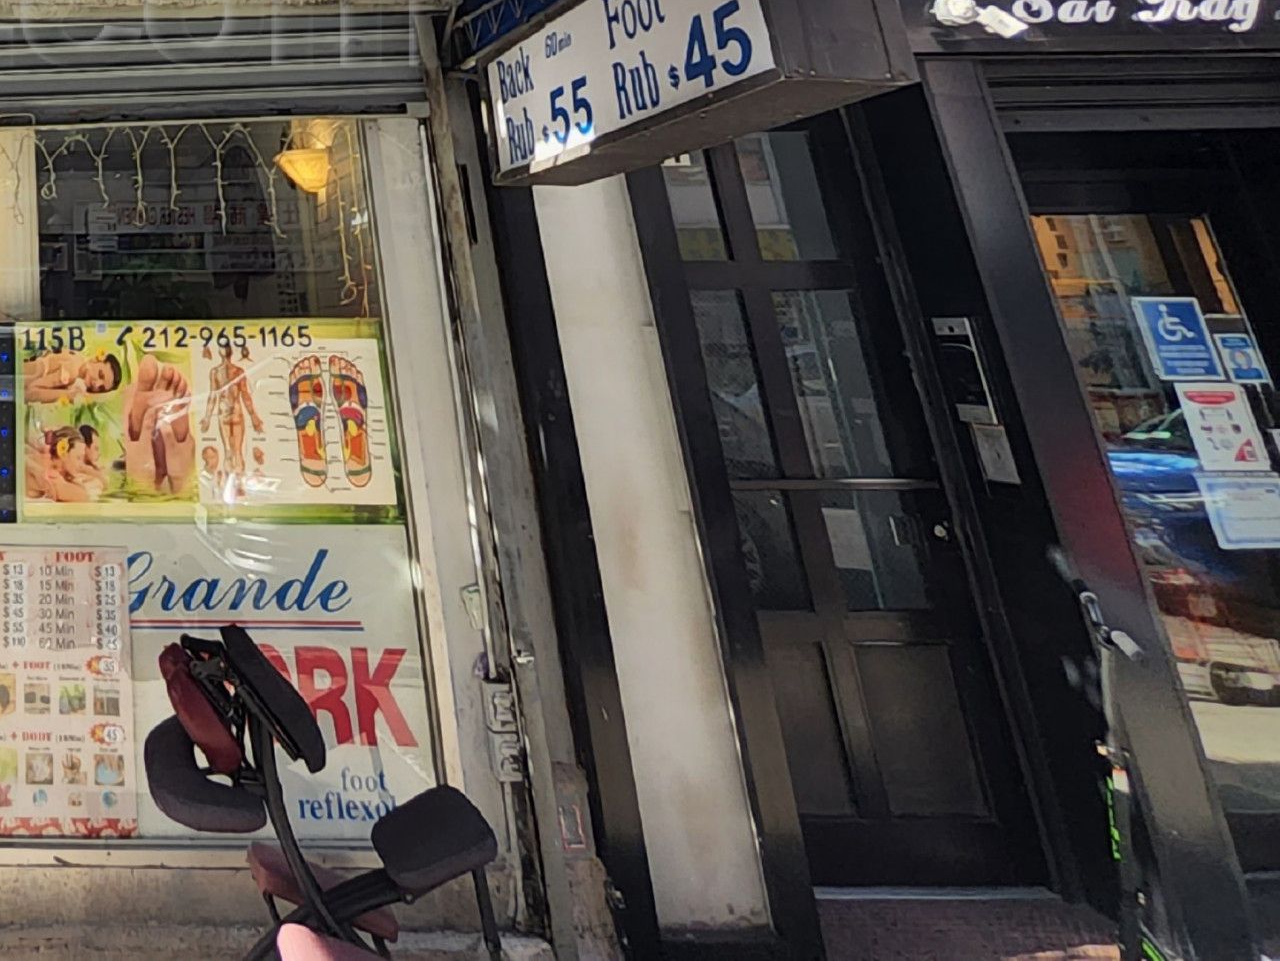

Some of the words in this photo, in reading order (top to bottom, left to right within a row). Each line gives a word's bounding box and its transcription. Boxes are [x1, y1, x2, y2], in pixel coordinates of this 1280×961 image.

[496, 46, 534, 104] Back
[612, 50, 660, 120] Rub
[506, 107, 535, 165] Rub
[22, 326, 85, 351] 115B
[142, 327, 313, 350] 212-965-1165
[55, 551, 94, 563] FOOT
[55, 566, 74, 576] Min
[55, 581, 74, 591] Min
[127, 549, 351, 614] Grande
[55, 594, 75, 605] Min
[55, 609, 75, 620] Min
[55, 623, 75, 634] Min
[55, 638, 75, 650] Min
[341, 765, 387, 792] foot
